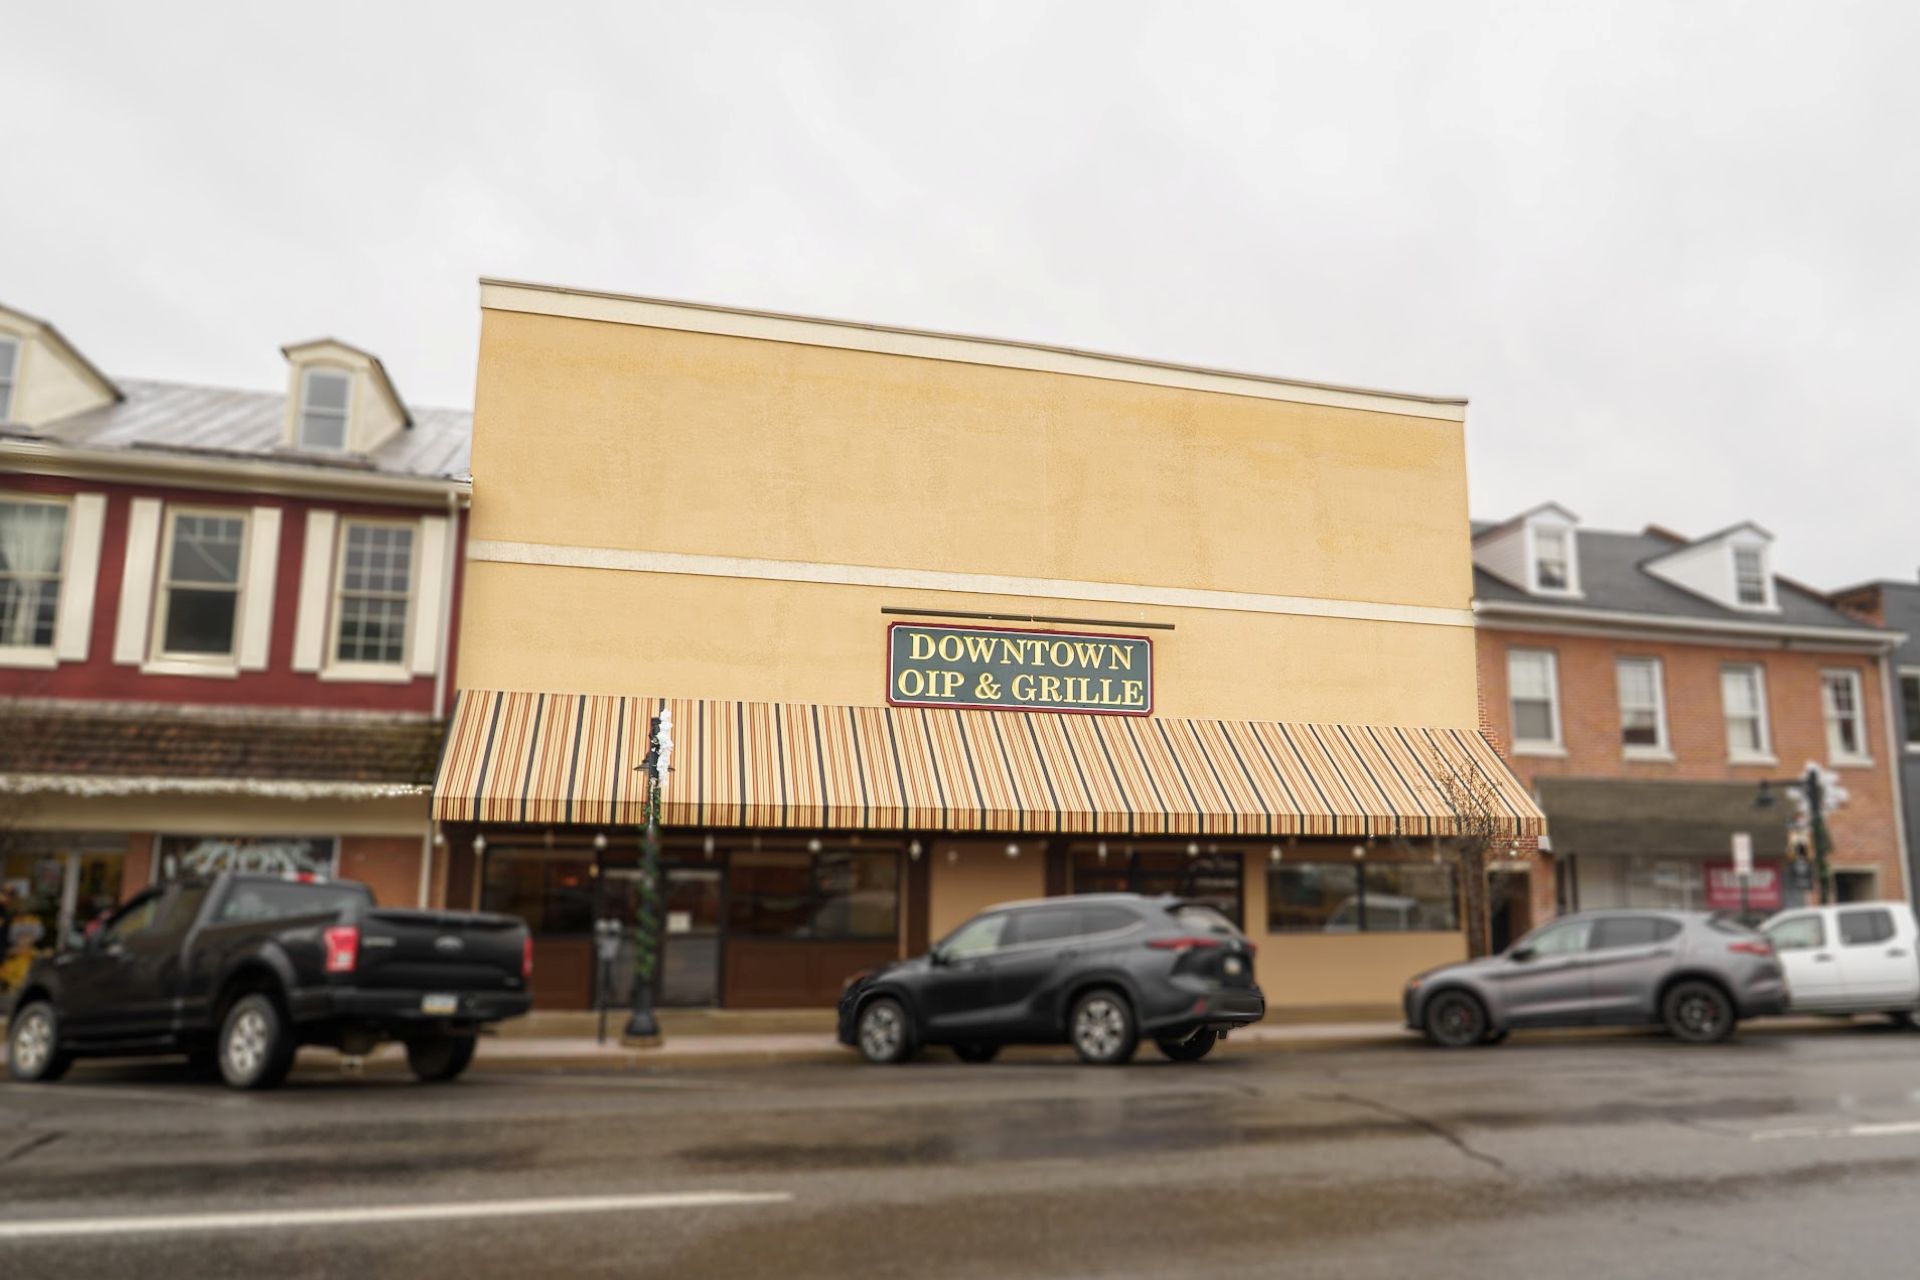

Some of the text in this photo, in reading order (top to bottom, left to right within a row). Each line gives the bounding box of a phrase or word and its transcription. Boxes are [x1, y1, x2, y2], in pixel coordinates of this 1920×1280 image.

[909, 633, 1133, 670] DOWNTOWN
[897, 669, 1144, 706] OIP & GRILLE
